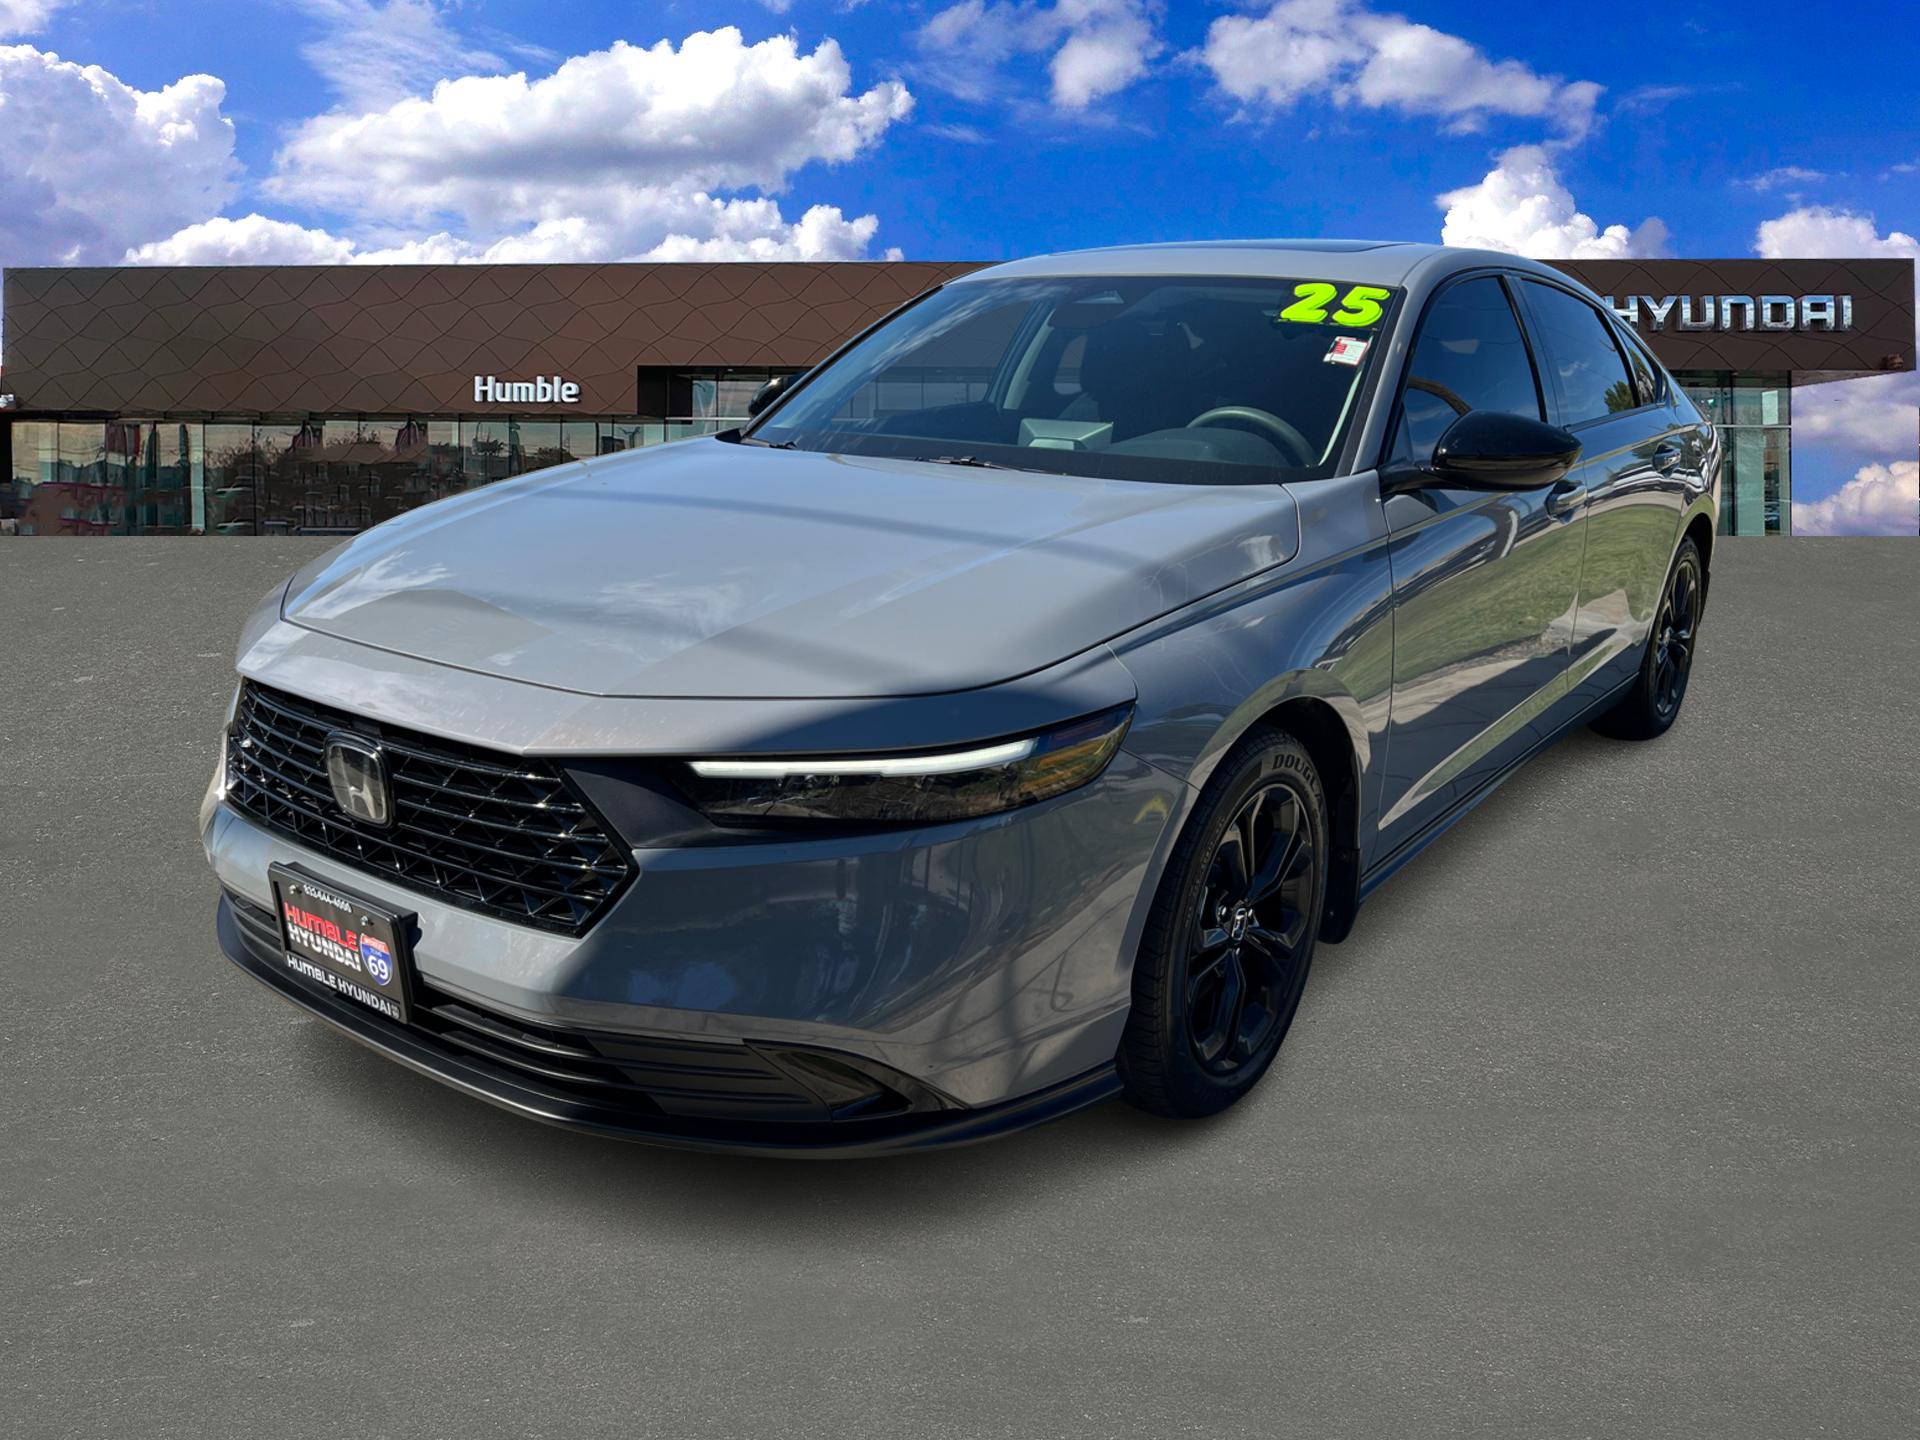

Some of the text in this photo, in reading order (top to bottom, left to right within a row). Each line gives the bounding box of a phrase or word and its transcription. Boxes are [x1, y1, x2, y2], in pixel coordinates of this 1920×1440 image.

[1280, 282, 1391, 328] 25
[1602, 295, 1852, 331] HYUNDAI
[474, 375, 580, 403] Humble
[284, 902, 360, 952] HUMBLE
[288, 922, 362, 972] HYUNDAI
[286, 954, 338, 989] HUMBLE
[337, 977, 392, 1017] HYUNDAI
[367, 955, 389, 980] 69
